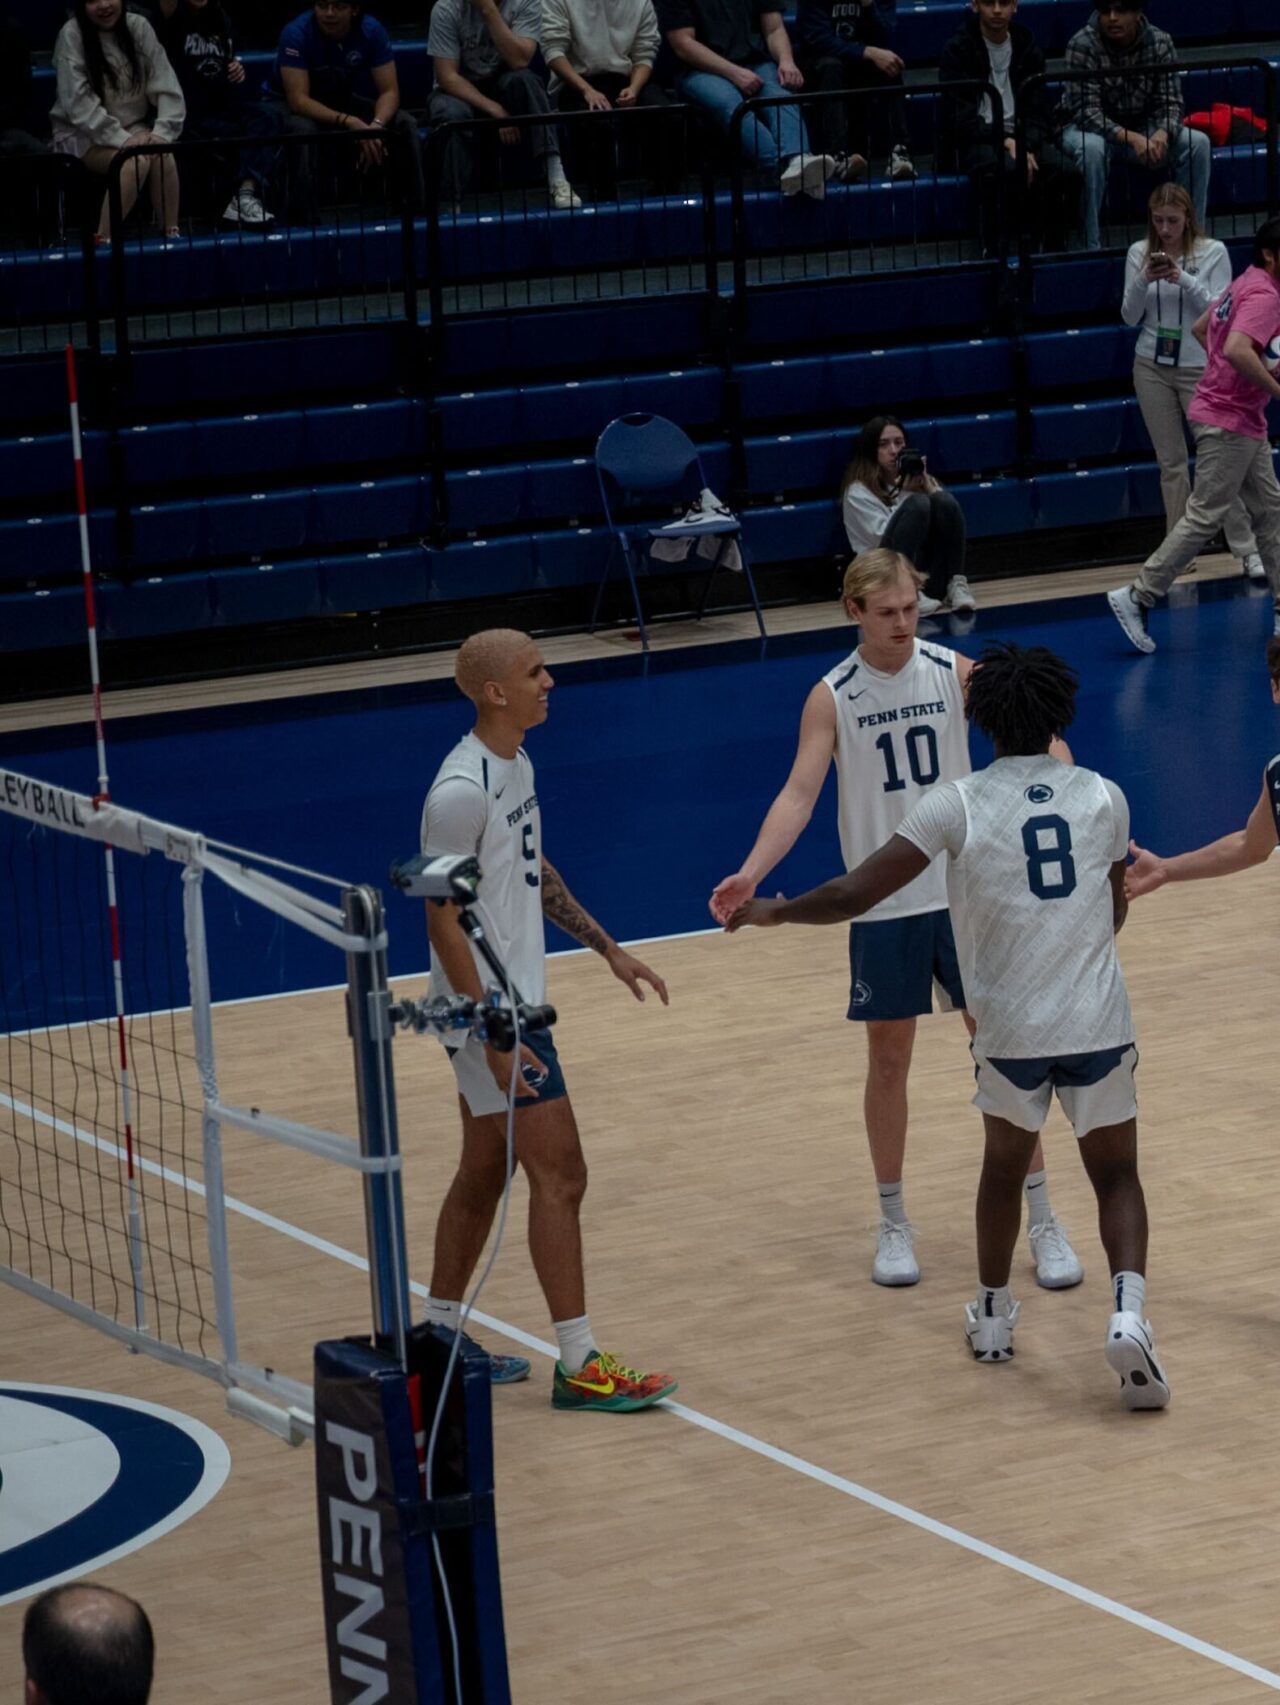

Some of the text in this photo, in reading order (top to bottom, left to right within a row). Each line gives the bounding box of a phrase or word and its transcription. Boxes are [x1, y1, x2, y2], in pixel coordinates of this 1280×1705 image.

[857, 701, 946, 728] PENN STATE
[875, 724, 940, 792] 10
[0, 774, 85, 828] EYBALL
[1021, 813, 1077, 900] 8
